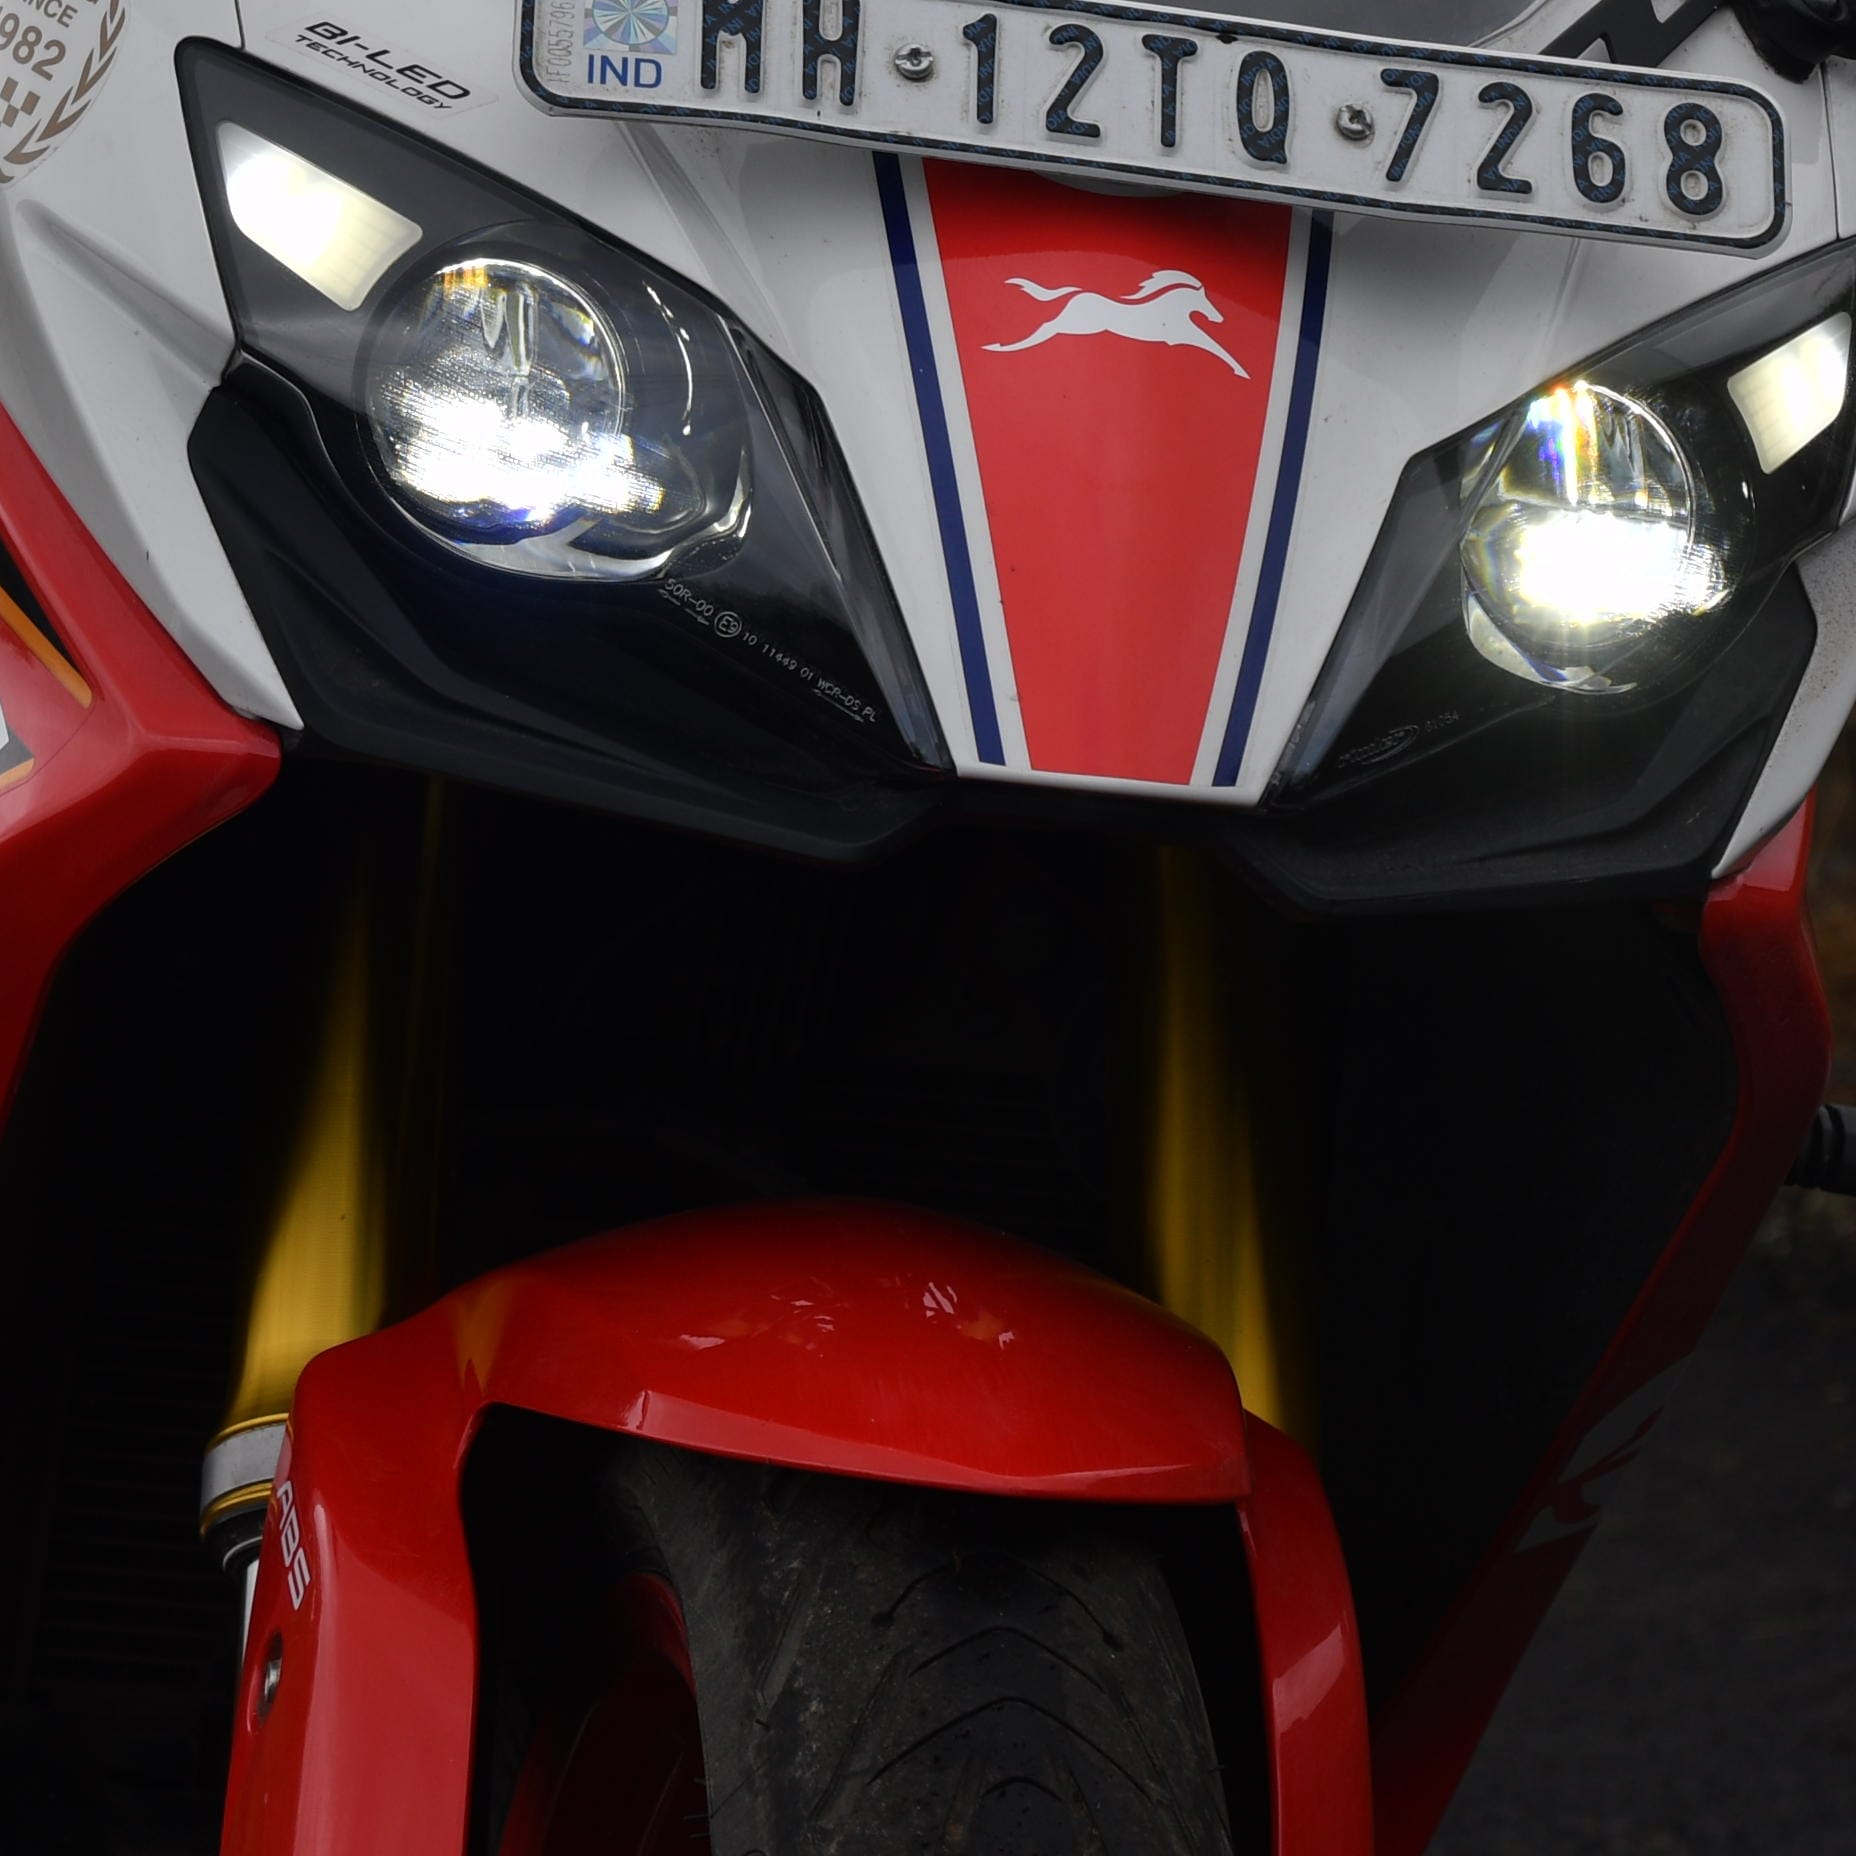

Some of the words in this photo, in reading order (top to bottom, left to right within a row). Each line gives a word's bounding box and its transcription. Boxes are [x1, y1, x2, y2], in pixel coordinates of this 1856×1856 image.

[295, 33, 453, 111] TECHNOLOGY
[303, 21, 472, 102] BI-LED
[587, 54, 663, 89] IND
[962, 13, 1290, 165] 12TQ
[1379, 67, 1724, 216] 7268
[743, 632, 758, 645] 10
[276, 1480, 312, 1611] ABS
